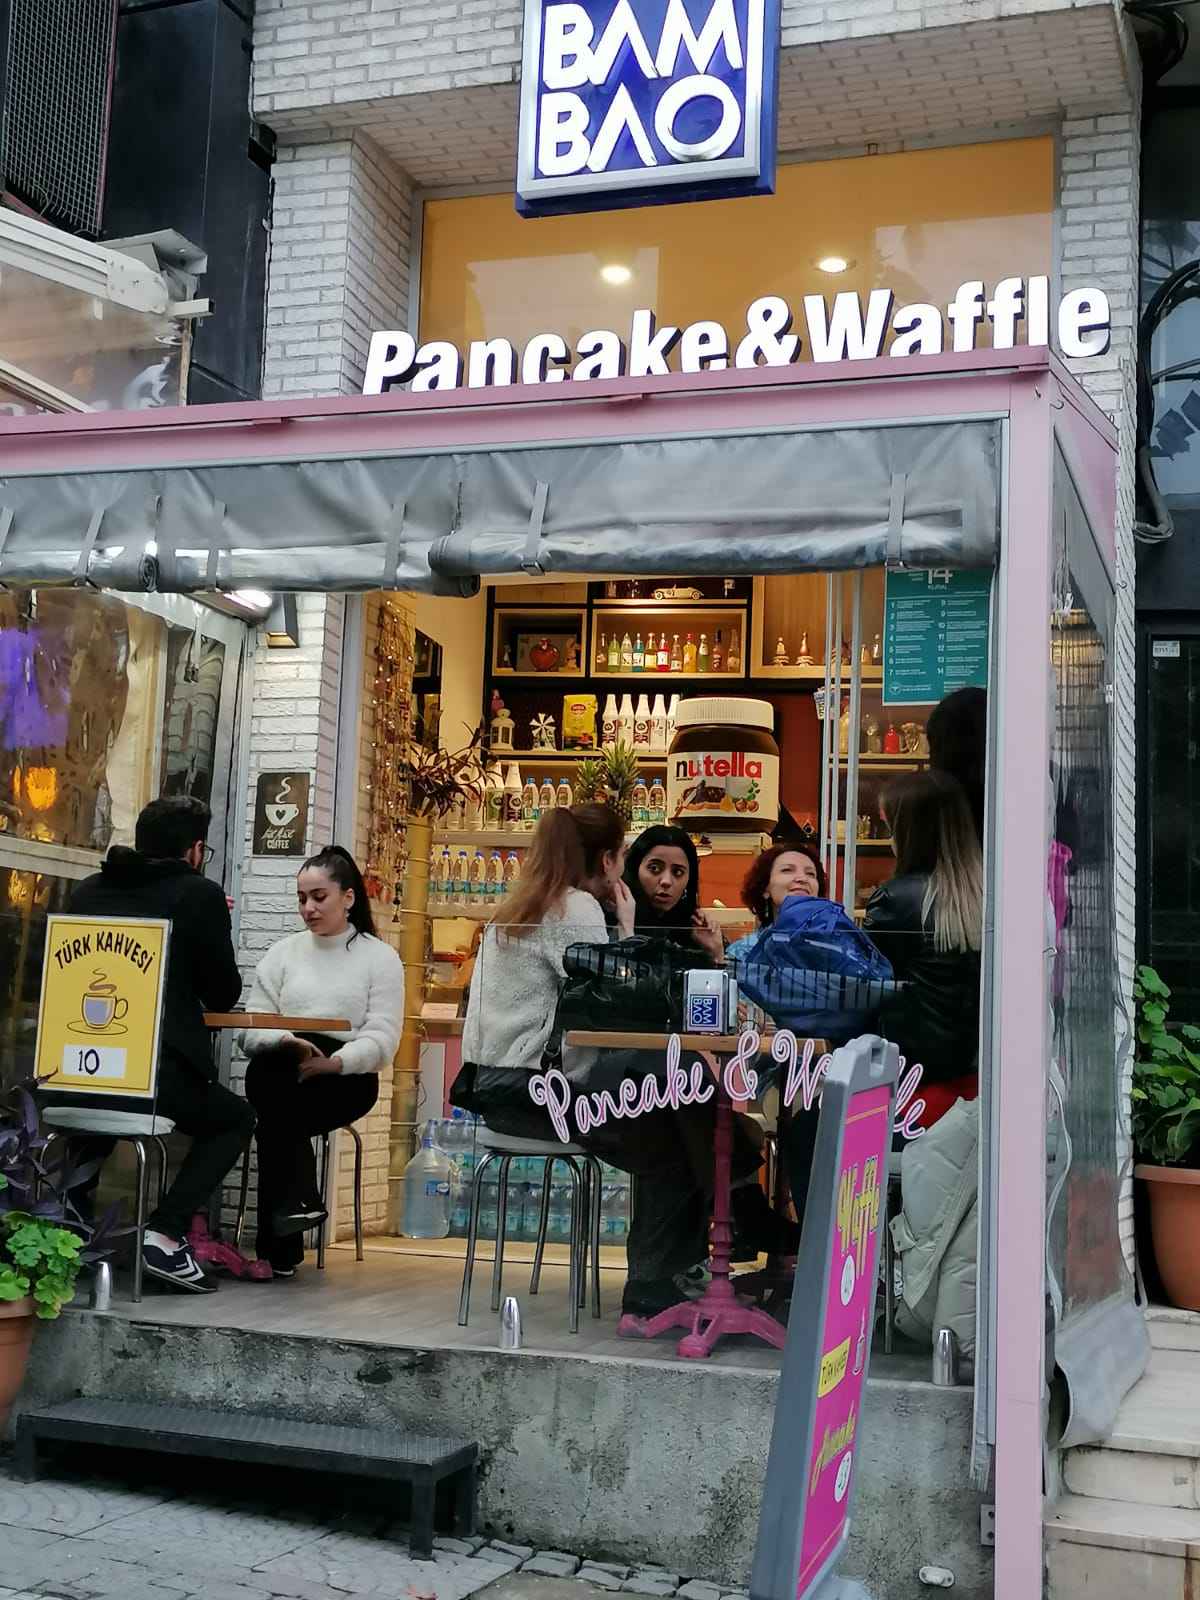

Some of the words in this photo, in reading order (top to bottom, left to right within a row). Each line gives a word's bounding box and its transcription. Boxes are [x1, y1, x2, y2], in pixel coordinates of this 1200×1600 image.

[543, 0, 744, 90] BAM
[538, 74, 742, 176] BAO
[676, 752, 762, 778] nutella
[266, 839, 290, 849] COFFEE
[55, 934, 91, 969] TÜRK
[96, 930, 156, 975] KAHVESİ
[692, 998, 702, 1024] BAO
[702, 998, 713, 1023] BAM
[78, 1048, 100, 1075] 10
[528, 1033, 715, 1144] Pancake
[723, 1029, 761, 1101] &
[771, 1029, 926, 1140] Wle
